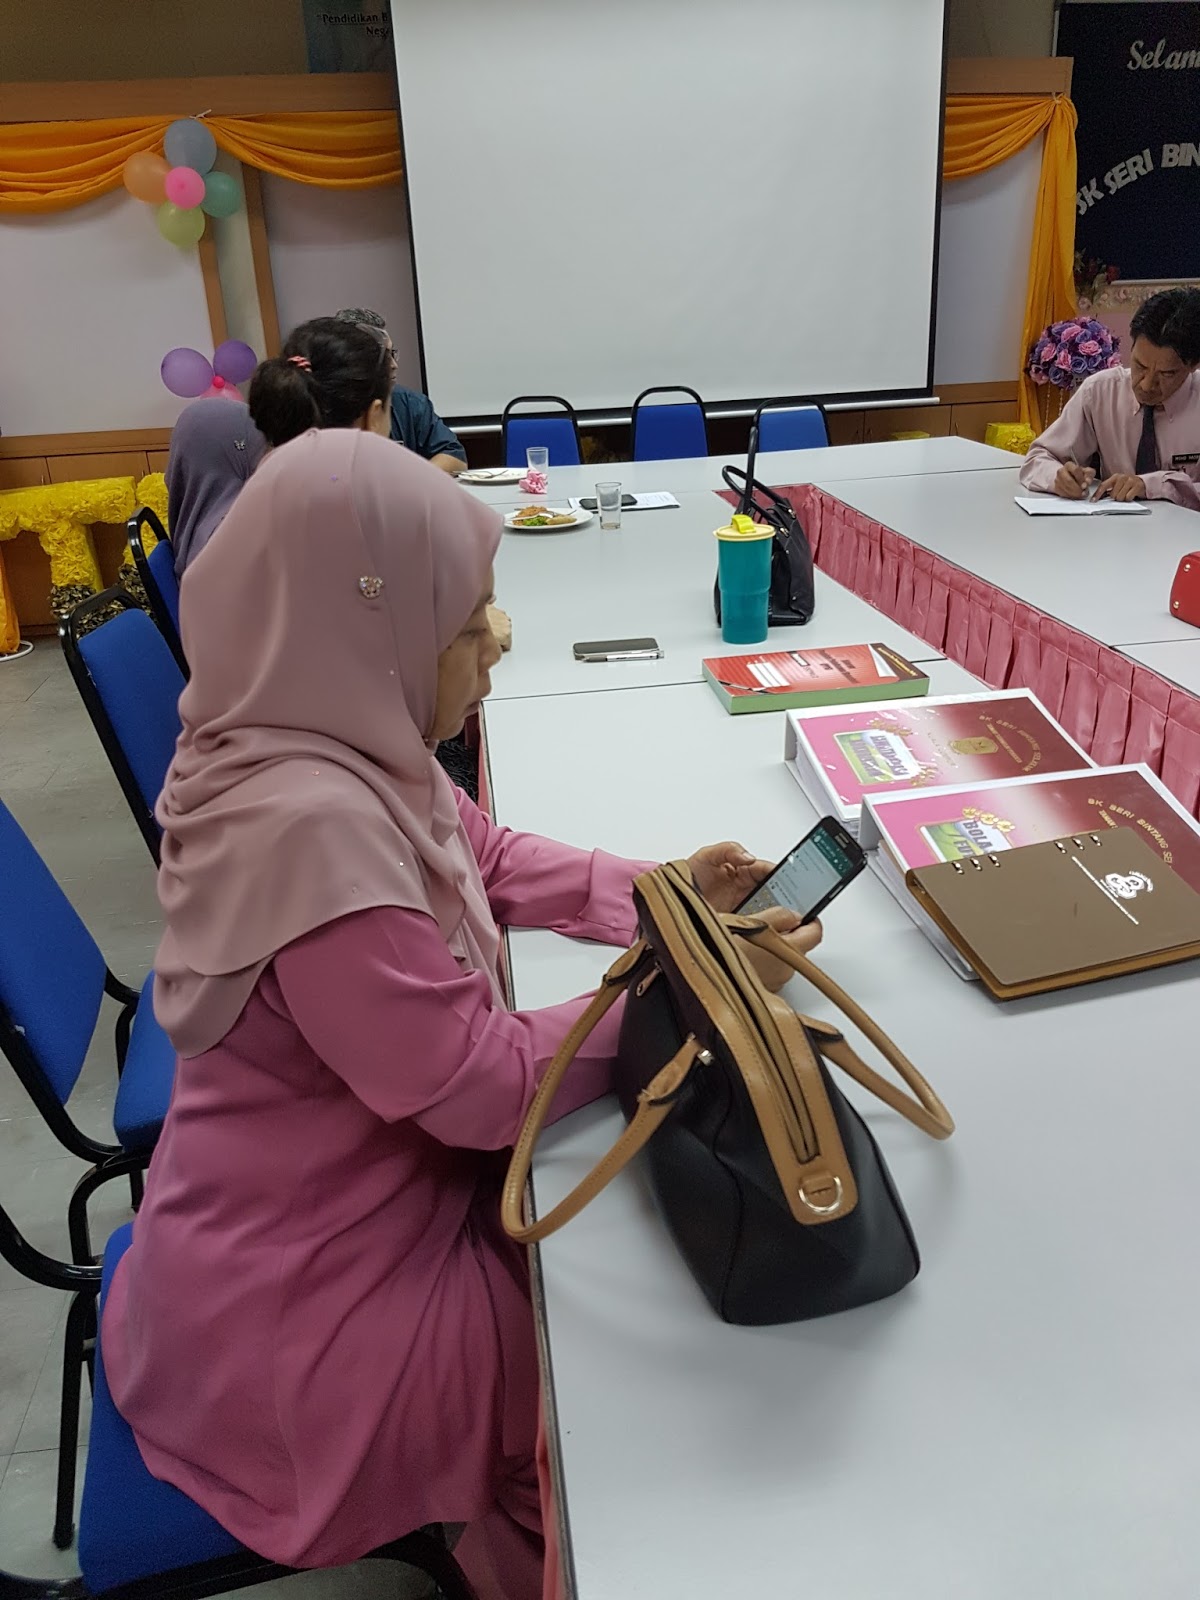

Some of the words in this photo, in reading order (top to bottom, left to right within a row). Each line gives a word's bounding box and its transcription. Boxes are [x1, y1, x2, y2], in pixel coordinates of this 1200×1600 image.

[1076, 177, 1104, 216] SK
[1103, 148, 1154, 195] SERI
[1161, 143, 1200, 168] BIN
[962, 821, 993, 849] BOLA
[1108, 804, 1135, 819] SERI
[1136, 818, 1169, 849] BINTANG
